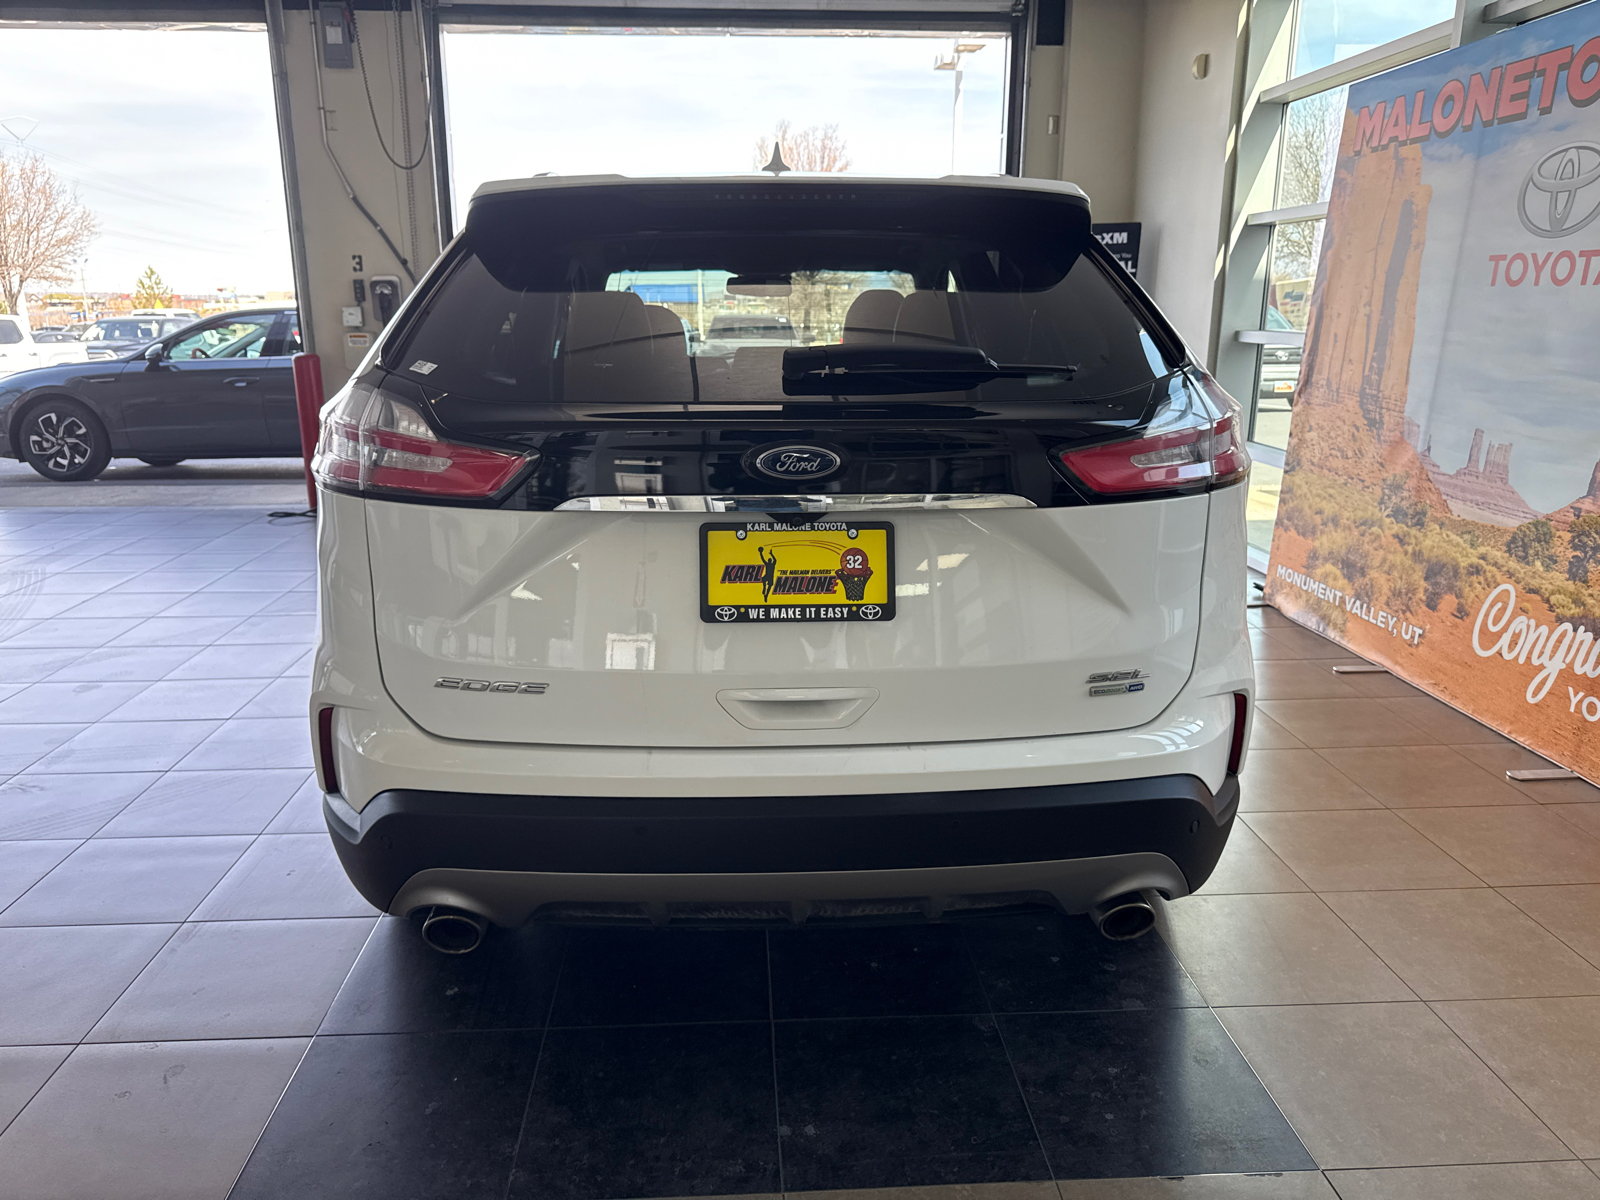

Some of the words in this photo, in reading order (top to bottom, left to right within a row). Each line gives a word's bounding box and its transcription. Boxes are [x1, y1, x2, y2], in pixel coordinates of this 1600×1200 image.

[352, 254, 363, 272] 3
[776, 452, 821, 472] Ford
[747, 523, 771, 531] KARL
[813, 522, 847, 531] TOYOTA
[846, 555, 863, 569] 32
[720, 564, 765, 584] KARL
[772, 576, 838, 595] MALONE
[748, 608, 766, 619] WE
[770, 607, 802, 619] MAKE
[806, 607, 815, 618] IT
[820, 607, 849, 618] EASY
[1277, 564, 1343, 606] MONUMENT
[1345, 595, 1397, 637] VALLEY,
[1401, 621, 1423, 645] UT
[1085, 667, 1151, 684] SEL
[433, 676, 550, 695] EDGE
[1129, 683, 1143, 692] AWD
